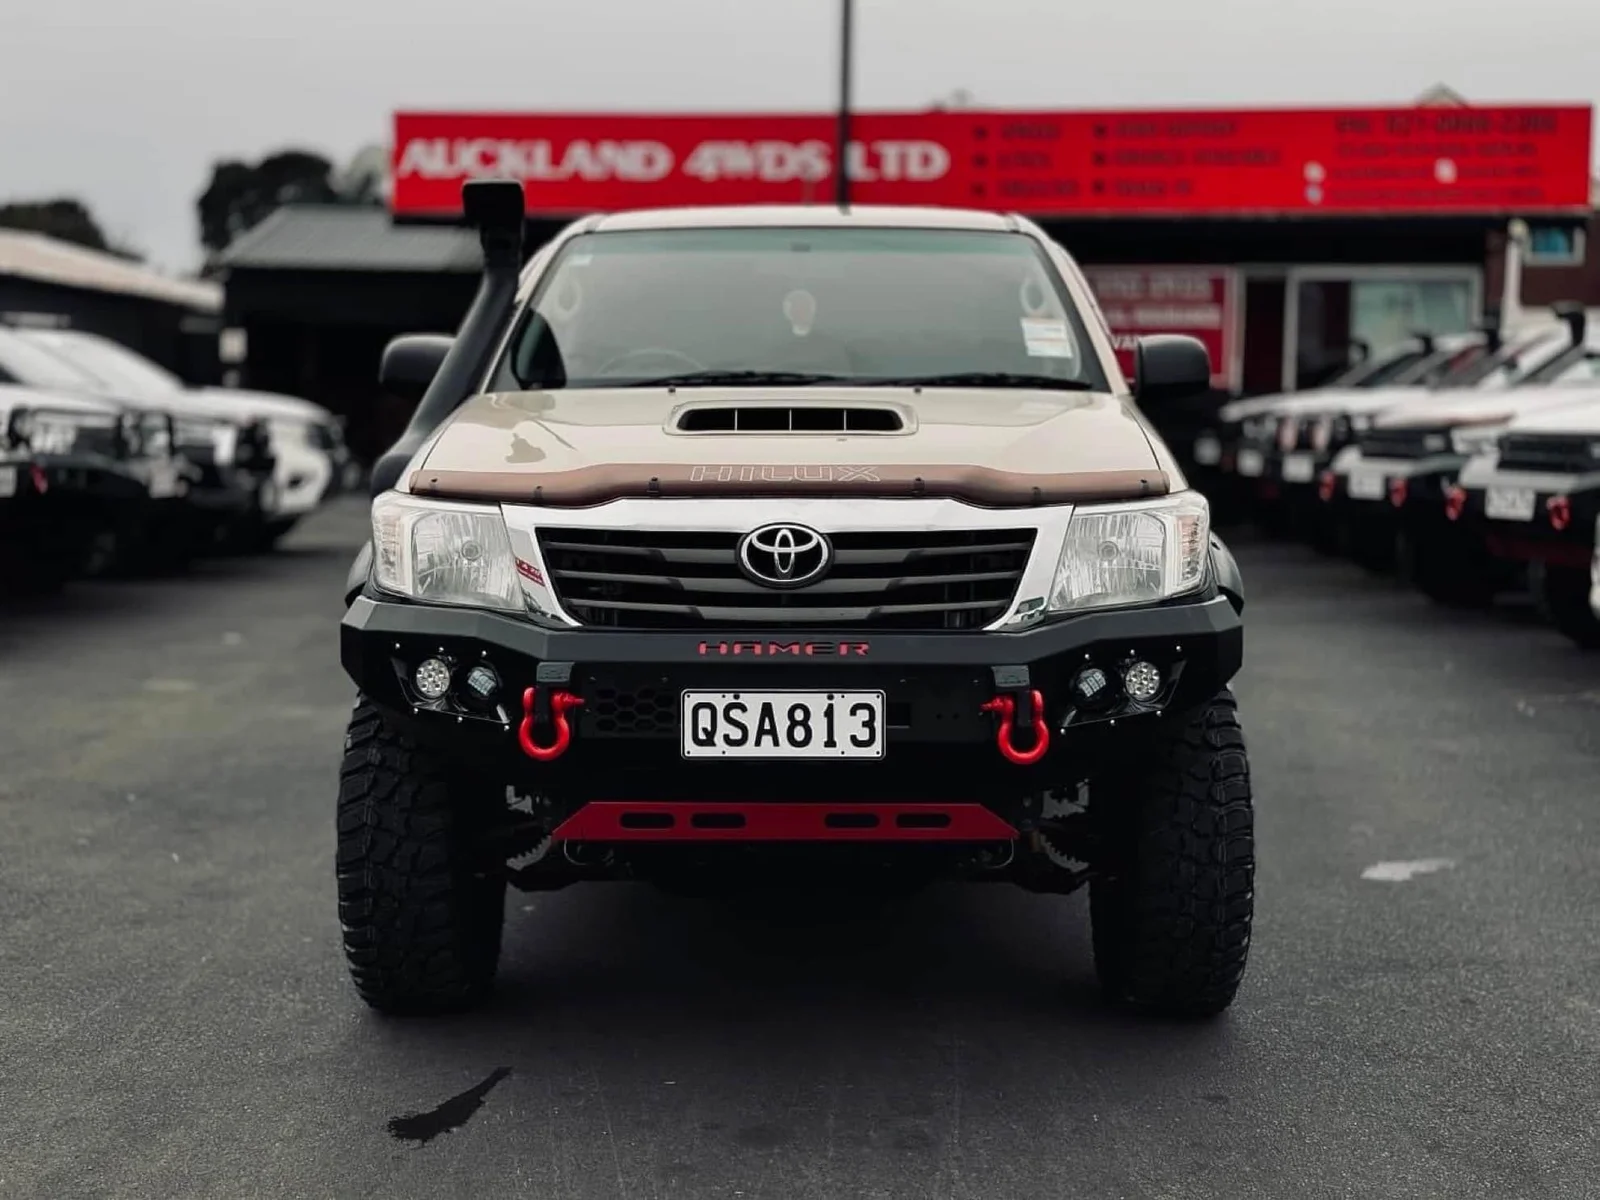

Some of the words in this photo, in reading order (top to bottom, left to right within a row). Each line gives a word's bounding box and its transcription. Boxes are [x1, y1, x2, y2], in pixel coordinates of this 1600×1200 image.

[399, 138, 675, 182] AUCKLAND
[683, 139, 831, 182] 4WDS
[846, 139, 950, 182] LTD
[690, 465, 881, 482] HILUX
[698, 641, 870, 656] HAMER
[691, 701, 876, 748] QSA813
